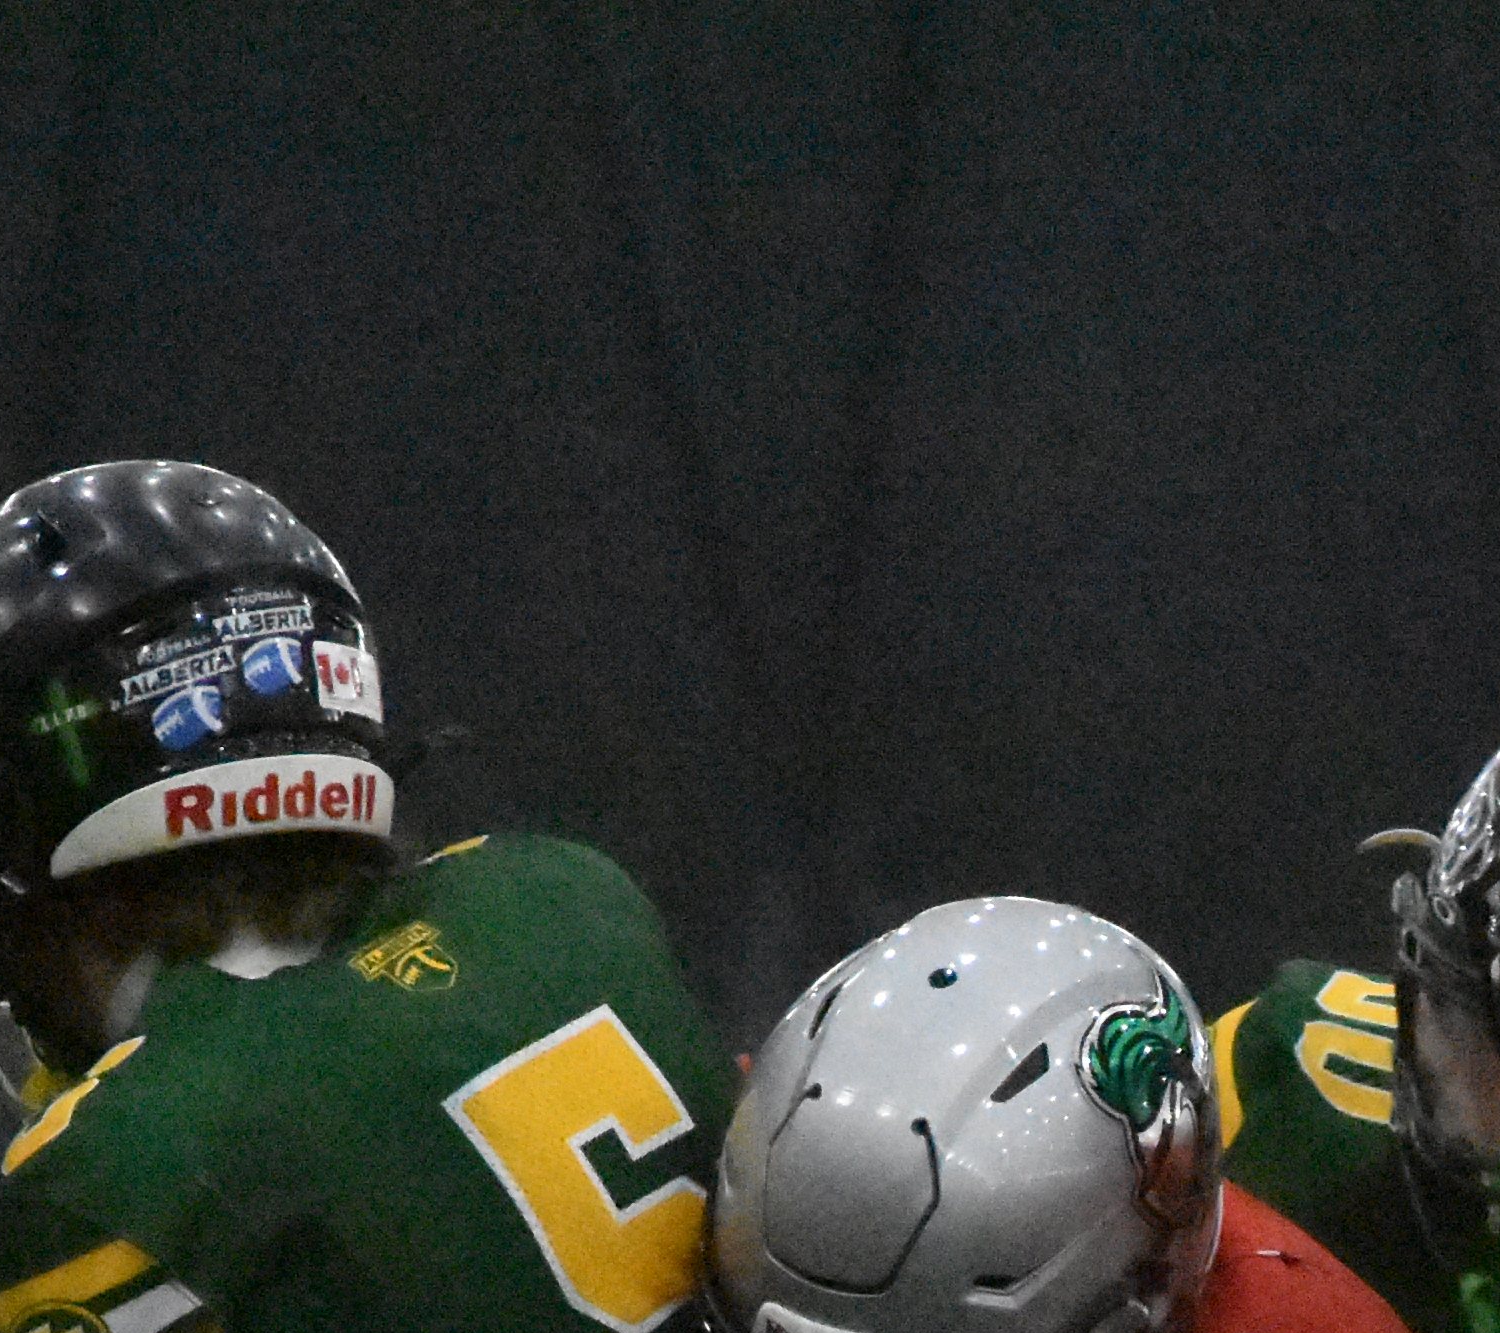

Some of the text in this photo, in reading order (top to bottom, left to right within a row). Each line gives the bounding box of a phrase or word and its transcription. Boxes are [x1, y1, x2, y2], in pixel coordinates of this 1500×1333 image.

[218, 606, 313, 640] ALBERTA
[124, 649, 234, 700] ALBERTA
[164, 770, 377, 837] Riddell
